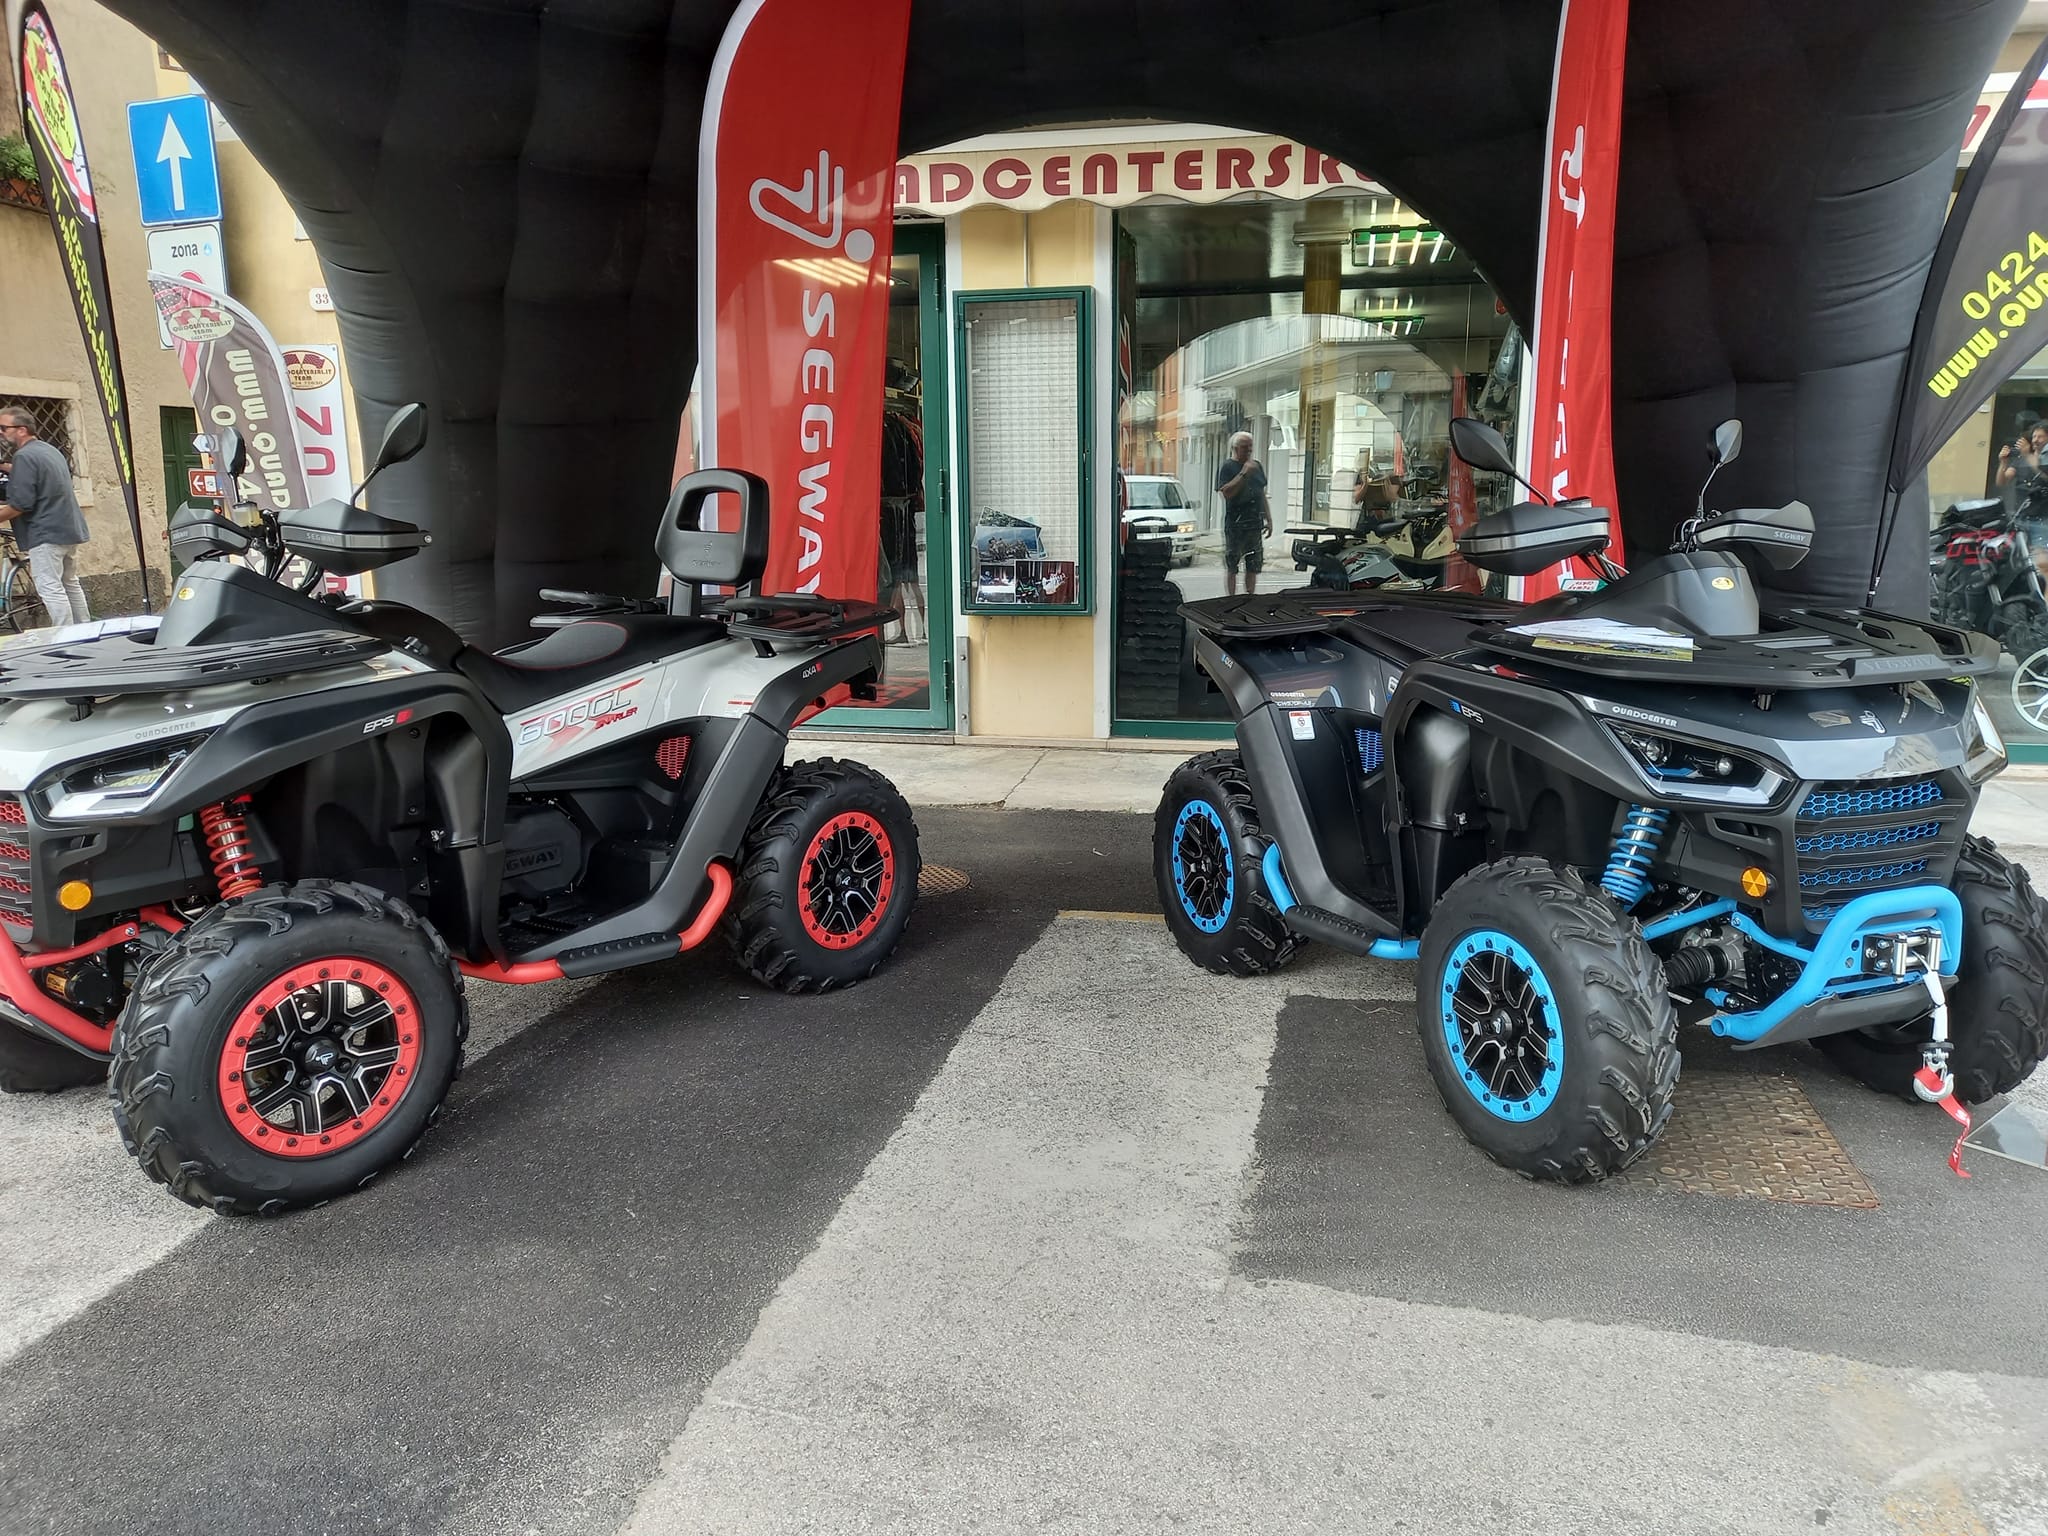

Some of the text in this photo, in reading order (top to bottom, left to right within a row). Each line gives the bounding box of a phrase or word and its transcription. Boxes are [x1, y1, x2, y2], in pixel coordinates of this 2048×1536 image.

[171, 243, 199, 258] zona
[315, 293, 330, 304] 33
[1773, 531, 1806, 542] SEGWAY
[1460, 704, 1484, 724] EPS
[1612, 706, 1678, 727] QUADCENTER
[135, 722, 196, 739] QUADCENTER
[363, 714, 395, 734] EPS
